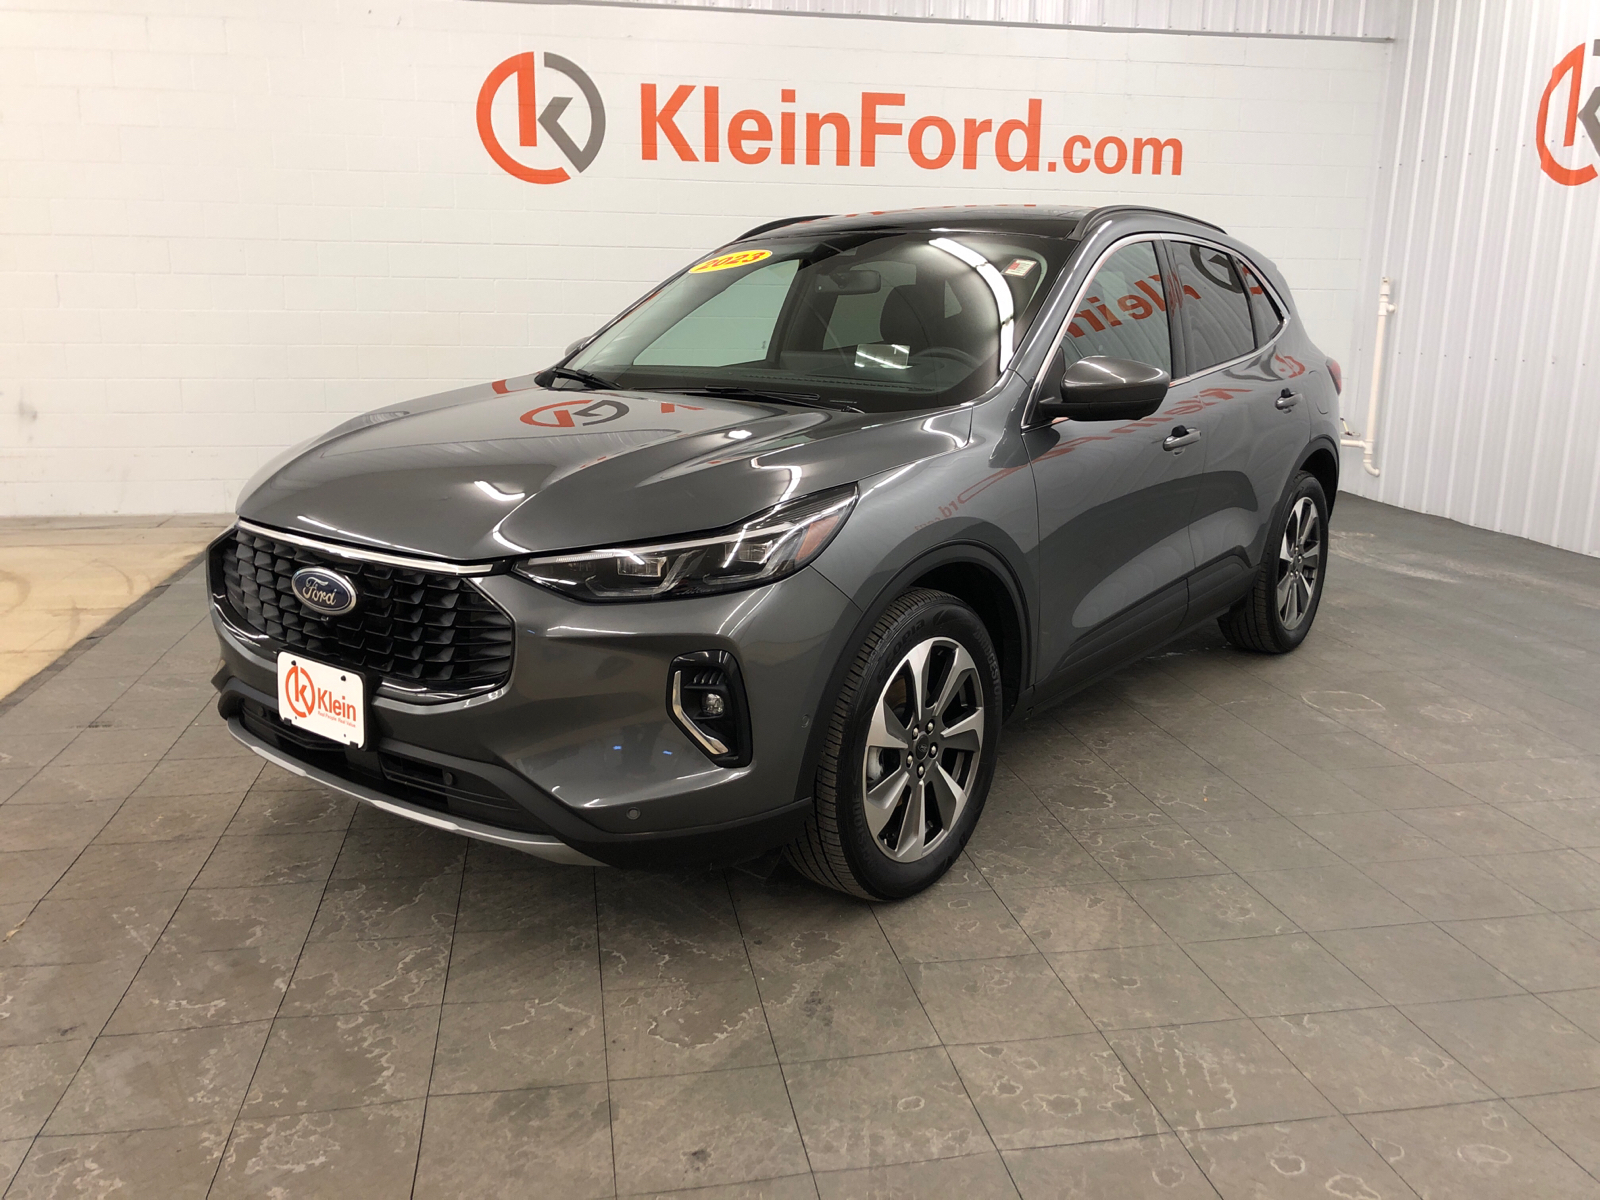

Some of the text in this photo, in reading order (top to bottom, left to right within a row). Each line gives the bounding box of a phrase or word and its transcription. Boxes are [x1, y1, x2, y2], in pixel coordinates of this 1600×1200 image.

[640, 82, 1184, 176] KleinFord.com
[694, 251, 766, 271] 2023
[302, 576, 338, 606] Ford
[316, 686, 357, 722] Klein
